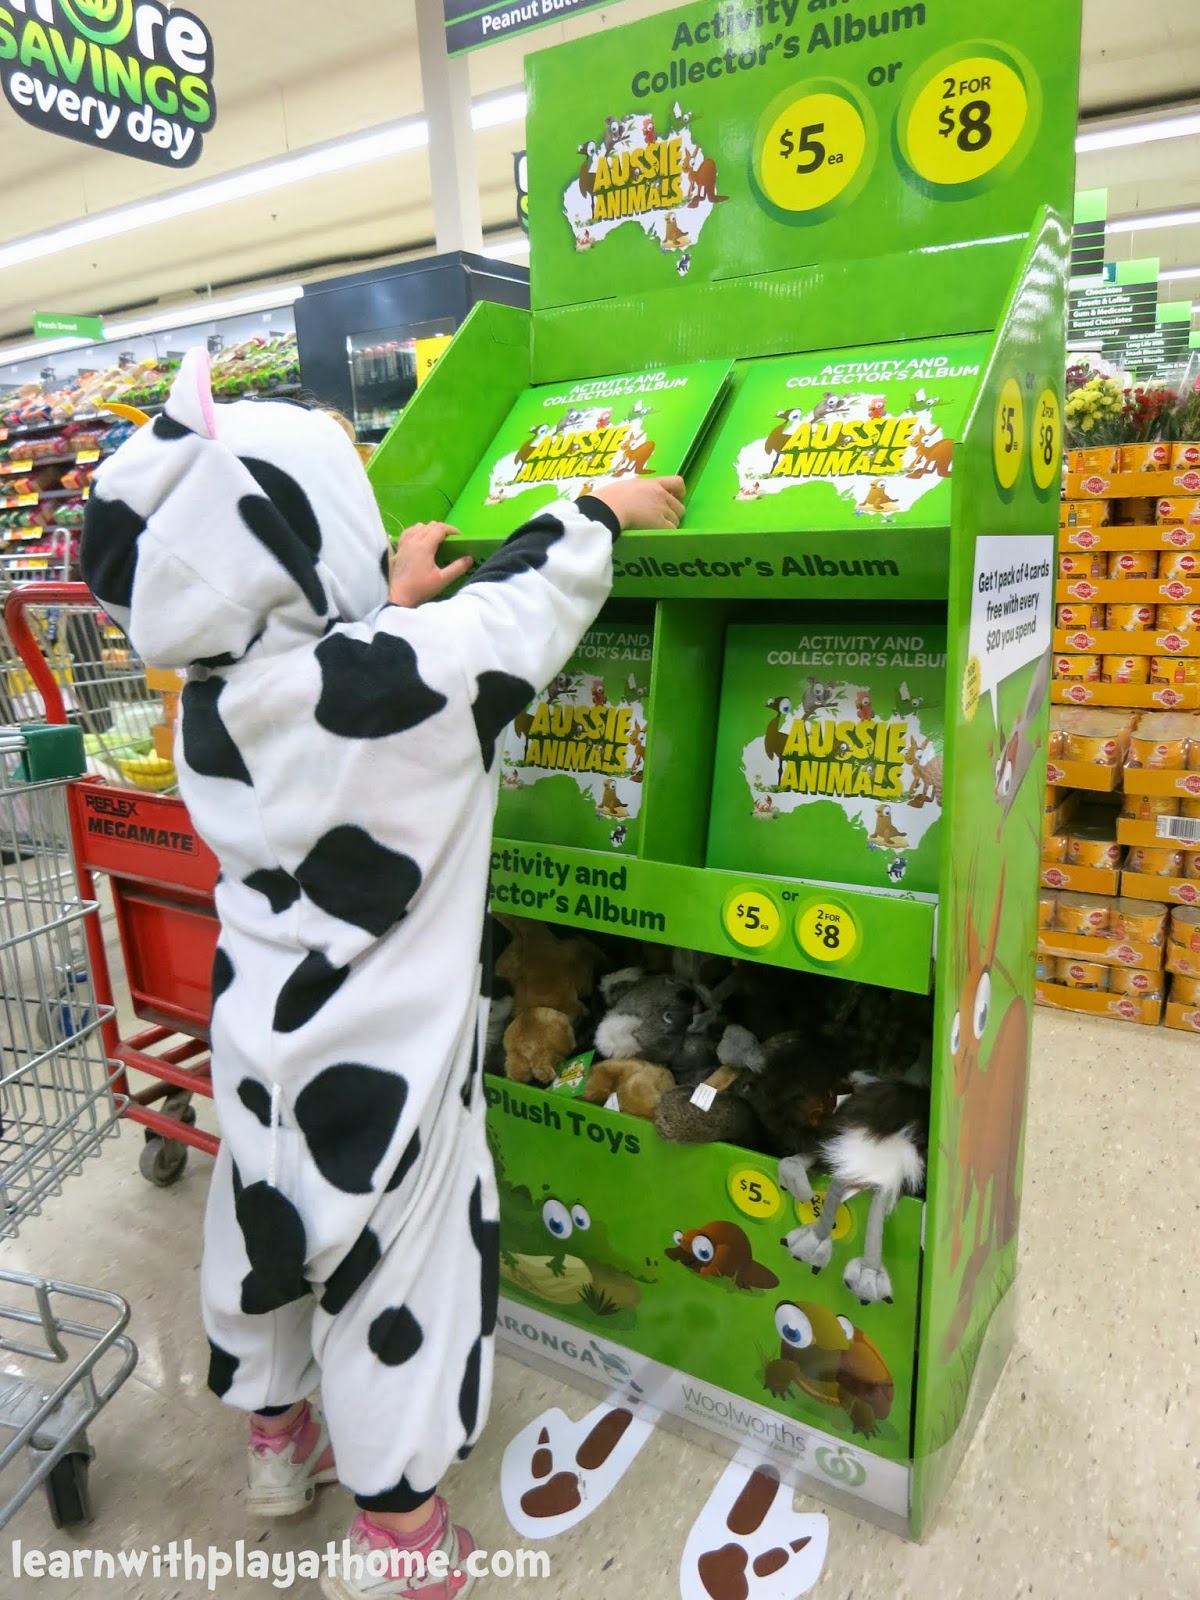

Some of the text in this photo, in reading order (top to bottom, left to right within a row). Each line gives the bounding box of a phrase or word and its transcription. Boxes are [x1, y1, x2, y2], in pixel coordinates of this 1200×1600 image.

[482, 2, 539, 35] Peanut
[671, 0, 799, 51] Activity
[631, 2, 926, 98] Collector's Album
[0, 10, 212, 124] SAVINGS
[867, 61, 903, 87] or
[941, 75, 991, 99] 2 FOR
[9, 72, 195, 160] every day
[938, 100, 992, 152] $8
[593, 137, 684, 193] AUSSIE
[778, 122, 844, 175] $5 ea
[594, 176, 684, 221] ANIMALS
[1085, 287, 1123, 296] Chocolates
[1073, 310, 1090, 318] Gum
[1097, 305, 1133, 316] Medicated
[1073, 317, 1132, 328] Boxed Chocolates
[1084, 329, 1120, 337] Stationery
[569, 371, 667, 394] ACTIVITY AND
[785, 364, 980, 389] COLLECTOR'S ALBUM
[820, 356, 948, 376] ACTIVITY AND
[542, 377, 688, 407] COLLECTOR'S ALBUM
[527, 425, 633, 460] AUSSIE
[786, 416, 920, 450] AUSSIE
[1001, 405, 1015, 454] $5
[1040, 423, 1054, 466] $8
[516, 451, 617, 483] ANIMALS
[773, 447, 907, 477] ANIMALS
[612, 554, 899, 578] Collector's Album
[978, 571, 994, 593] Get
[997, 565, 1016, 593] pack
[1016, 563, 1024, 583] of
[1029, 559, 1050, 579] cards
[986, 592, 1040, 622] free with every
[581, 631, 650, 647] VITY AND
[797, 635, 924, 651] ACTIVITY AND
[986, 616, 1037, 654] $20 you spend
[621, 648, 651, 661] ALB
[766, 651, 887, 667] COLLECTOR'S
[528, 703, 634, 744] AUSSIE
[525, 738, 628, 774] ANIMALS
[782, 719, 908, 764] AUSSIE
[779, 760, 905, 799] ANIMALS
[85, 794, 139, 818] REFLEX
[88, 817, 193, 851] MEGAMATE
[491, 848, 627, 891] ctivity and
[488, 882, 666, 932] ector's Album
[781, 890, 799, 901] or
[736, 903, 760, 929] $5
[817, 909, 841, 922] 2 FOR
[814, 922, 840, 949] $8
[484, 1085, 640, 1154] Plush Toys
[739, 1178, 763, 1203] $5
[497, 1315, 598, 1368] RONGA
[682, 1383, 806, 1452] Woolworths
